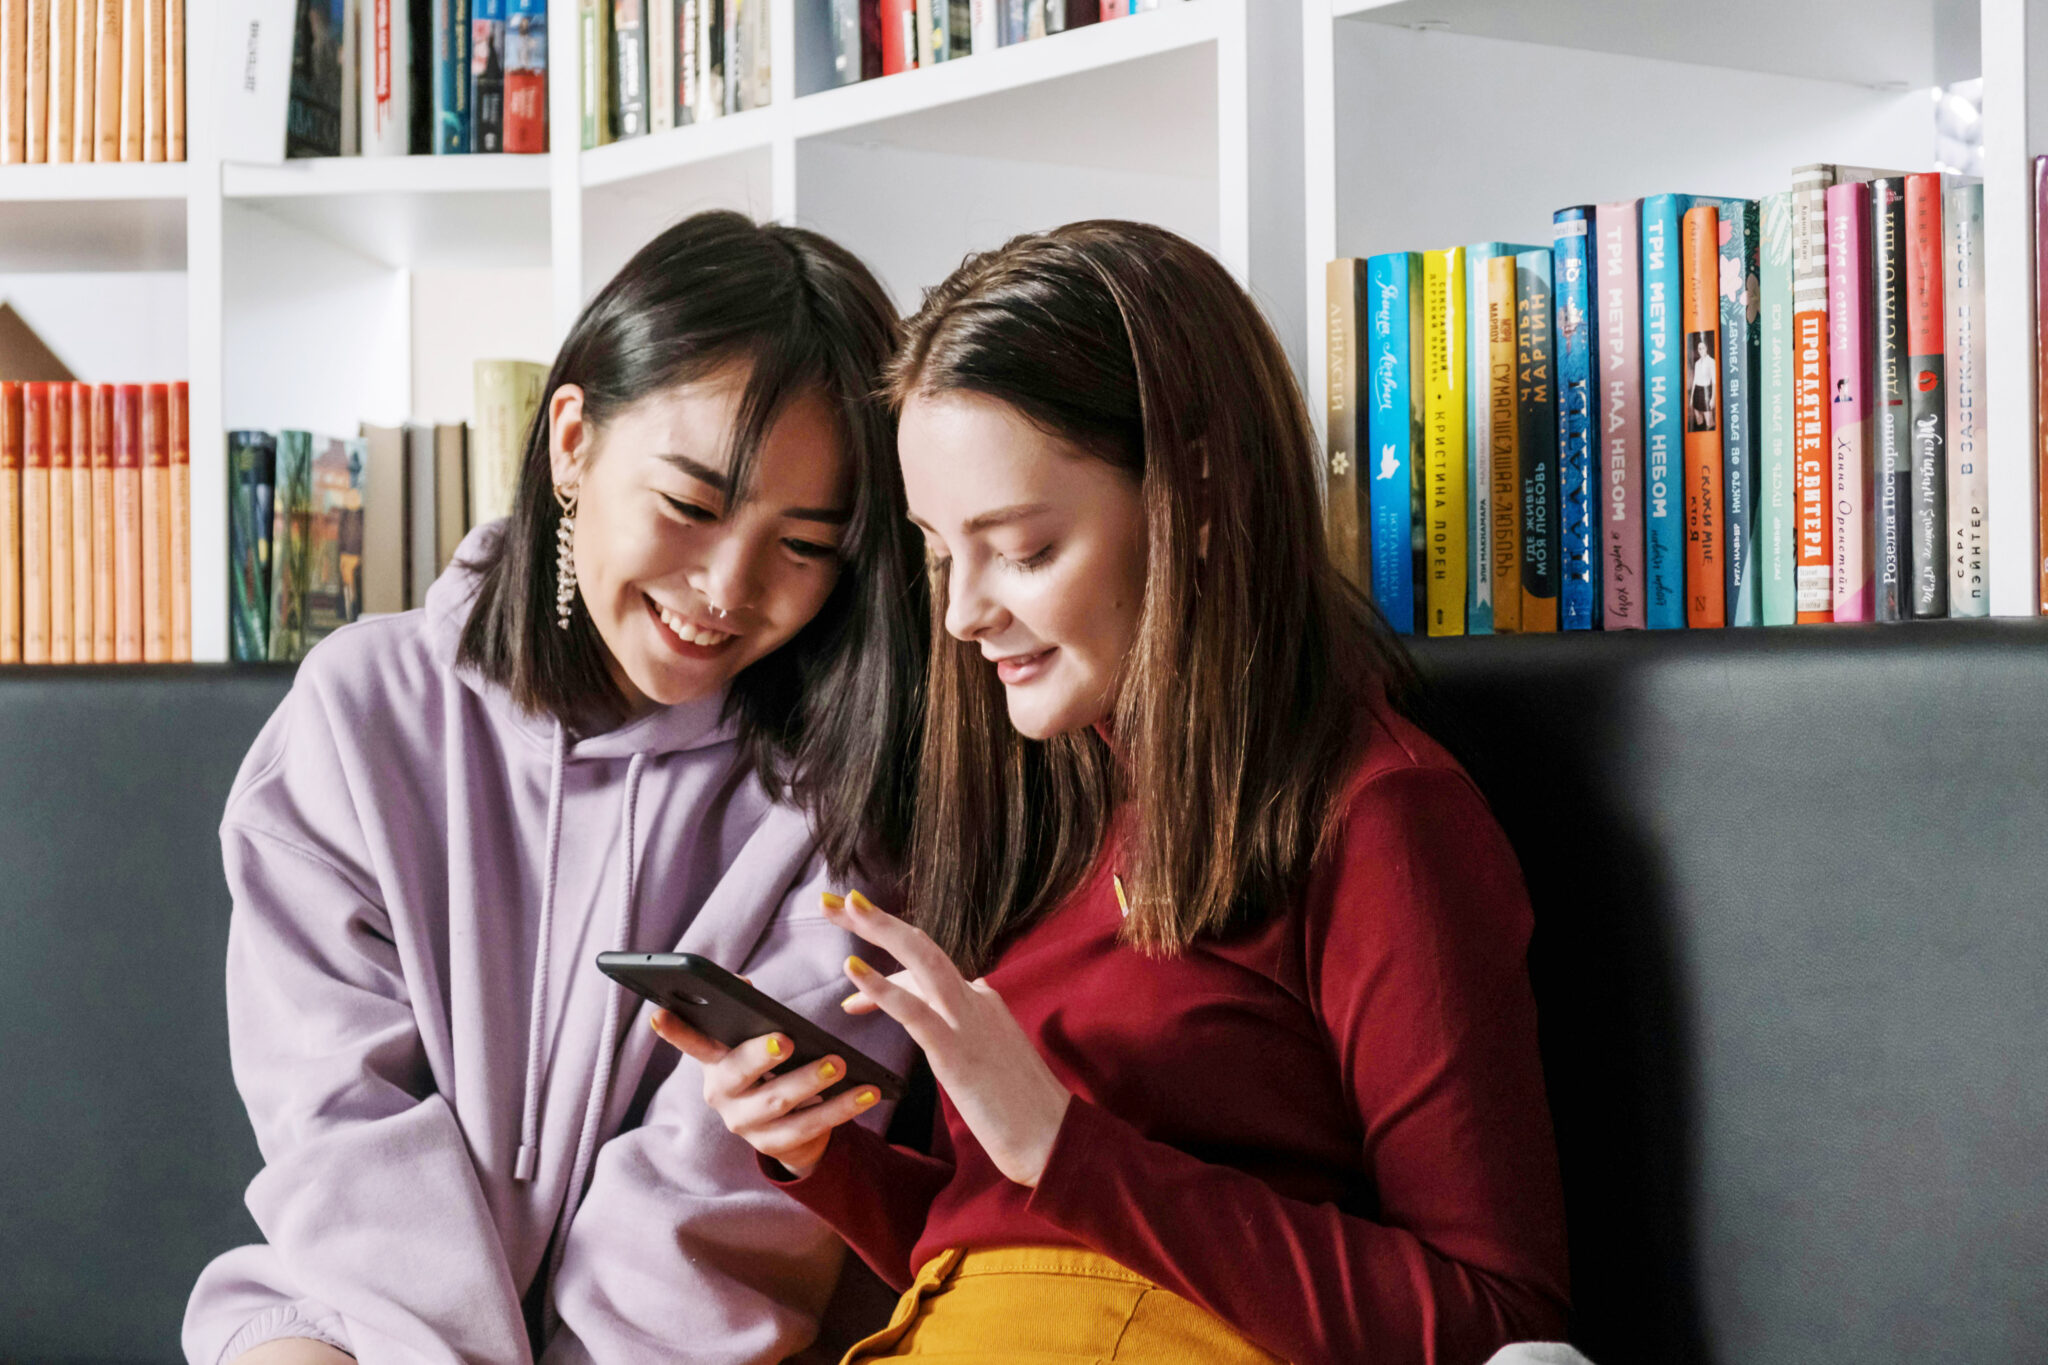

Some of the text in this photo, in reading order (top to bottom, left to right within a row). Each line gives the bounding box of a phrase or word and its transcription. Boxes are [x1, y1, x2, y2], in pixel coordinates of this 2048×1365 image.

[1831, 215, 1849, 267] Игра
[1430, 273, 1438, 328] ДЕРЗКИЙ
[1439, 282, 1449, 372] СЕКСУАЛЬНЫЙ
[1519, 299, 1531, 401] ЧАРЛЬЗ
[1531, 293, 1547, 402] МАРТИН
[1882, 211, 1898, 393] ДЕГУСТАТОРШИ
[1330, 303, 1345, 411] ЛИНДСЕЙ
[1607, 226, 1626, 521] ТРИ МЕТРА НАД НЕБОМ
[1649, 219, 1667, 518] ТРИ МЕТРА НАД НЕБОМ
[1772, 303, 1783, 507] ПУСТЬ ОБ ЭТОМ ЗНАЮТ ВСЕ
[1802, 317, 1821, 450] ПРОКЛЯТИЕ
[1958, 304, 1972, 452] ЗАЗЕРКАЛЬЕ
[1729, 319, 1741, 513] НИКТО ОБ ЭТОМ НЕ УЗНАЕТ
[1917, 414, 1943, 503] Женщины
[1434, 411, 1446, 580] КРИСТИНА ЛОРЕН
[1535, 461, 1547, 576] МОЯ ЛЮБОВЬ
[1701, 465, 1713, 566] СКАЖИ МНЕ
[1804, 461, 1821, 558] СВИТЕРА
[1837, 437, 1853, 595] Ханна Оренстейн
[1882, 412, 1898, 584] Розелла Посторино
[1961, 462, 1973, 475] В
[1479, 498, 1487, 584] ЭЛИ МАКНАМАРА
[1495, 502, 1514, 578] ЛЮБОВЬ
[1525, 477, 1536, 562] ГДЕ ЖИВЕТ
[1733, 523, 1742, 586] РИТА НАВЬЕР
[1774, 556, 1782, 581] РИТА
[1970, 506, 1981, 598] ПЭЙНТЕР
[1609, 588, 1633, 618] хочу
